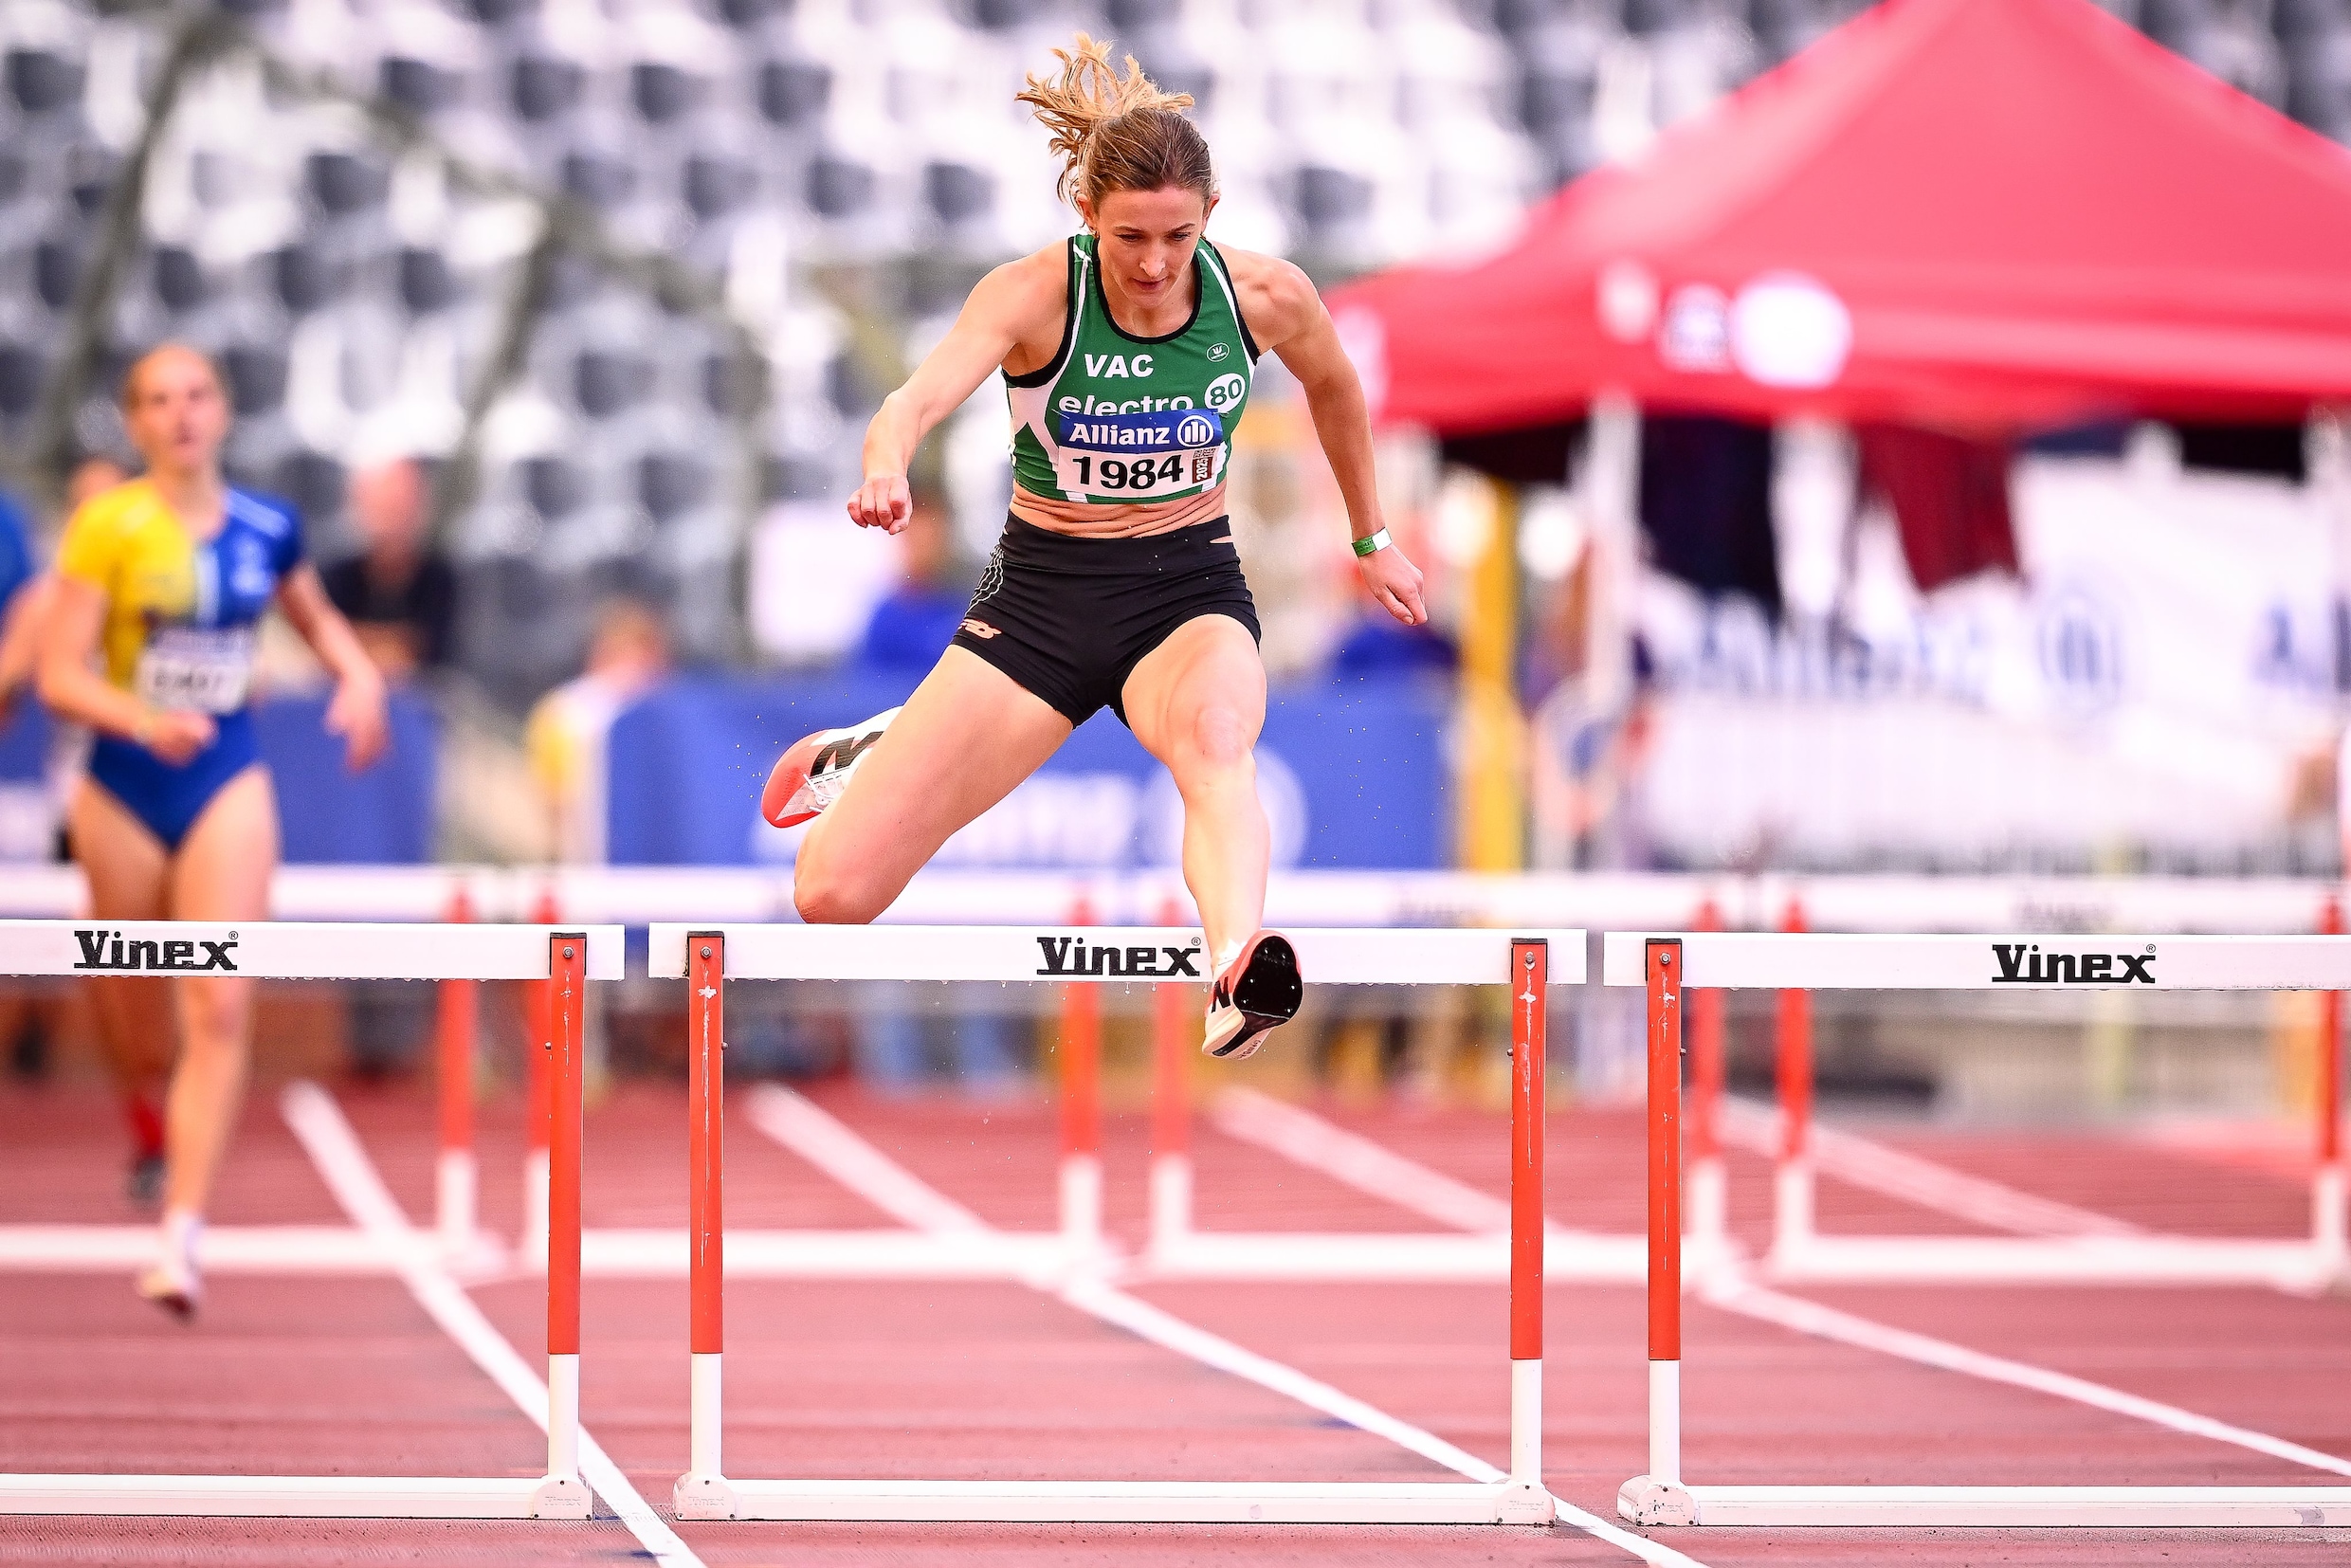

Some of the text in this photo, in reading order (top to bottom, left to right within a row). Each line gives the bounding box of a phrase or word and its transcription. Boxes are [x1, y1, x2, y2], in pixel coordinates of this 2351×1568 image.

[1084, 354, 1154, 378] VAC
[1210, 378, 1242, 407] 80
[1068, 423, 1171, 446] Allianz
[1072, 454, 1184, 490] 1984
[1195, 457, 1210, 481] 2025
